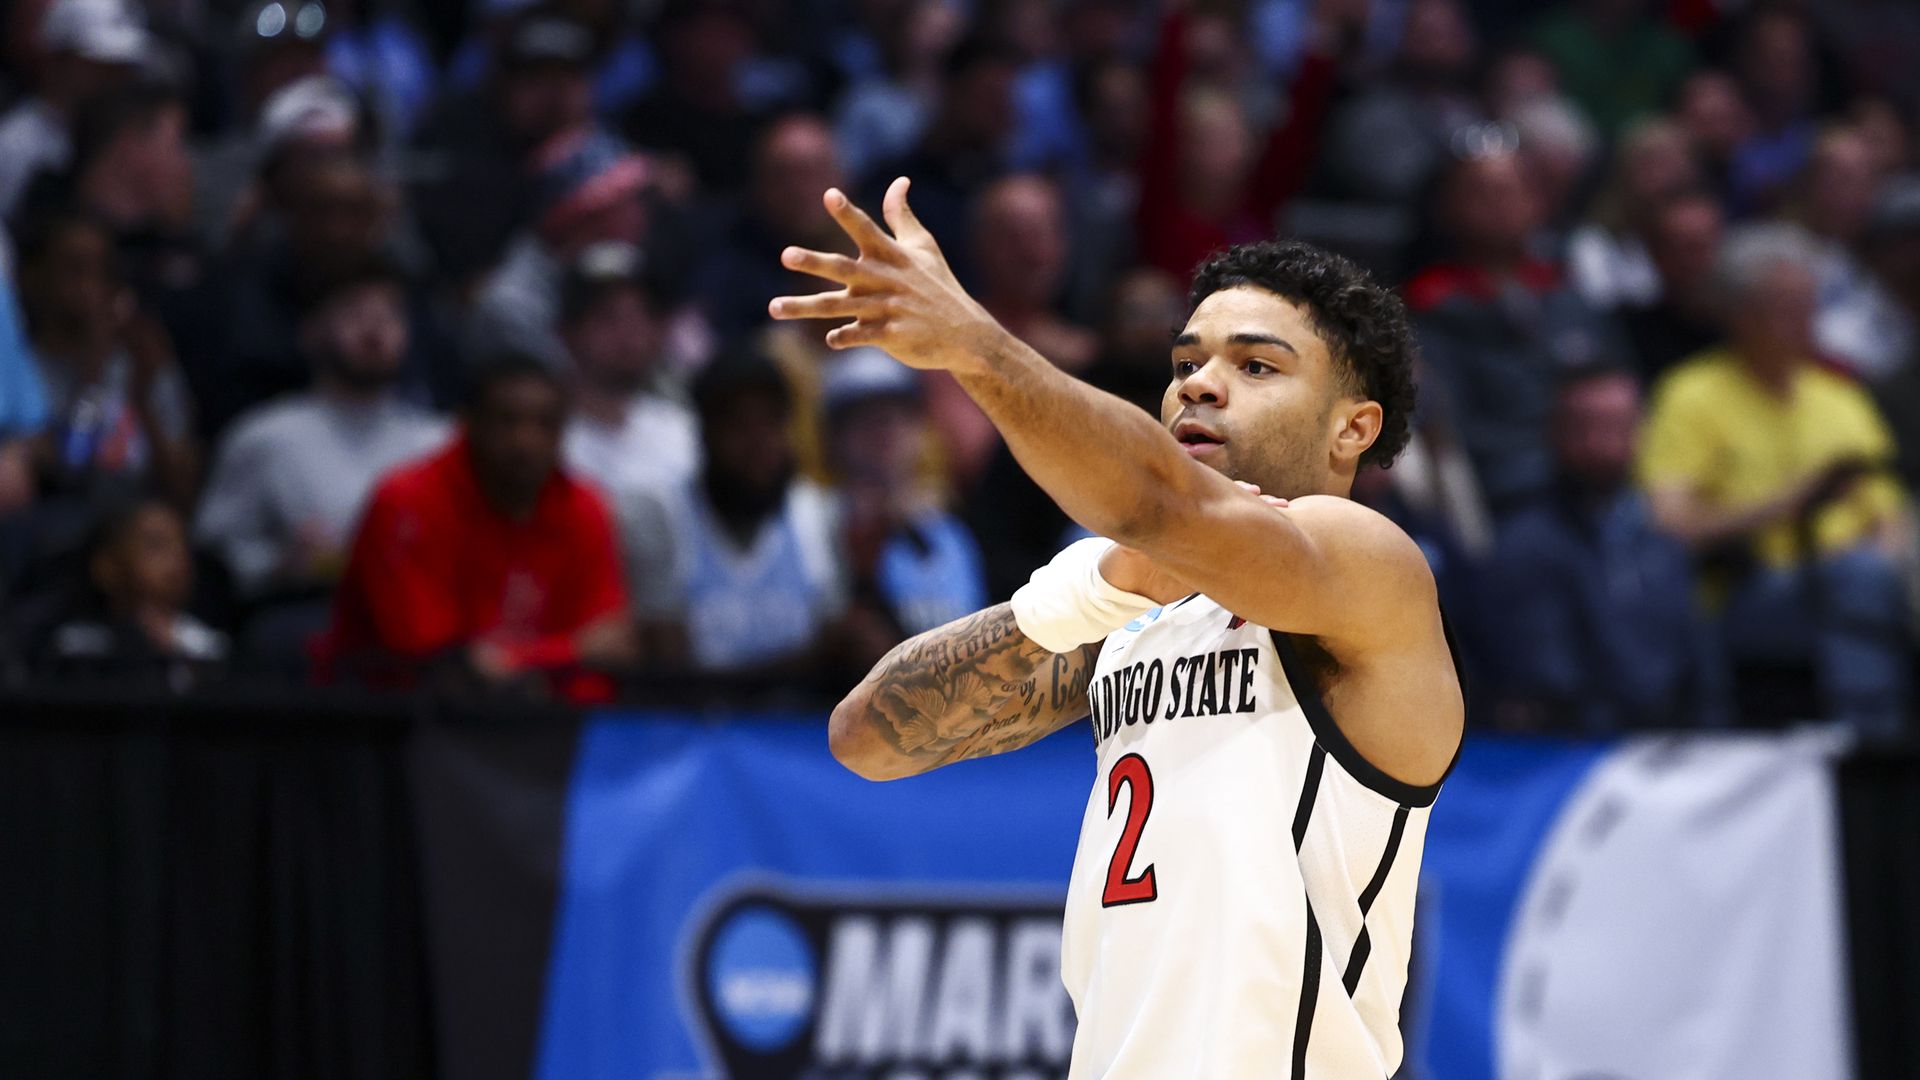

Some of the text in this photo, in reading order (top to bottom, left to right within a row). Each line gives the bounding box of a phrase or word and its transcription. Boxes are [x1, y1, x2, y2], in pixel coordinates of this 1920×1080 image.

[1165, 648, 1259, 720] STATE
[1102, 752, 1158, 908] 2
[818, 912, 1068, 1062] MAR
